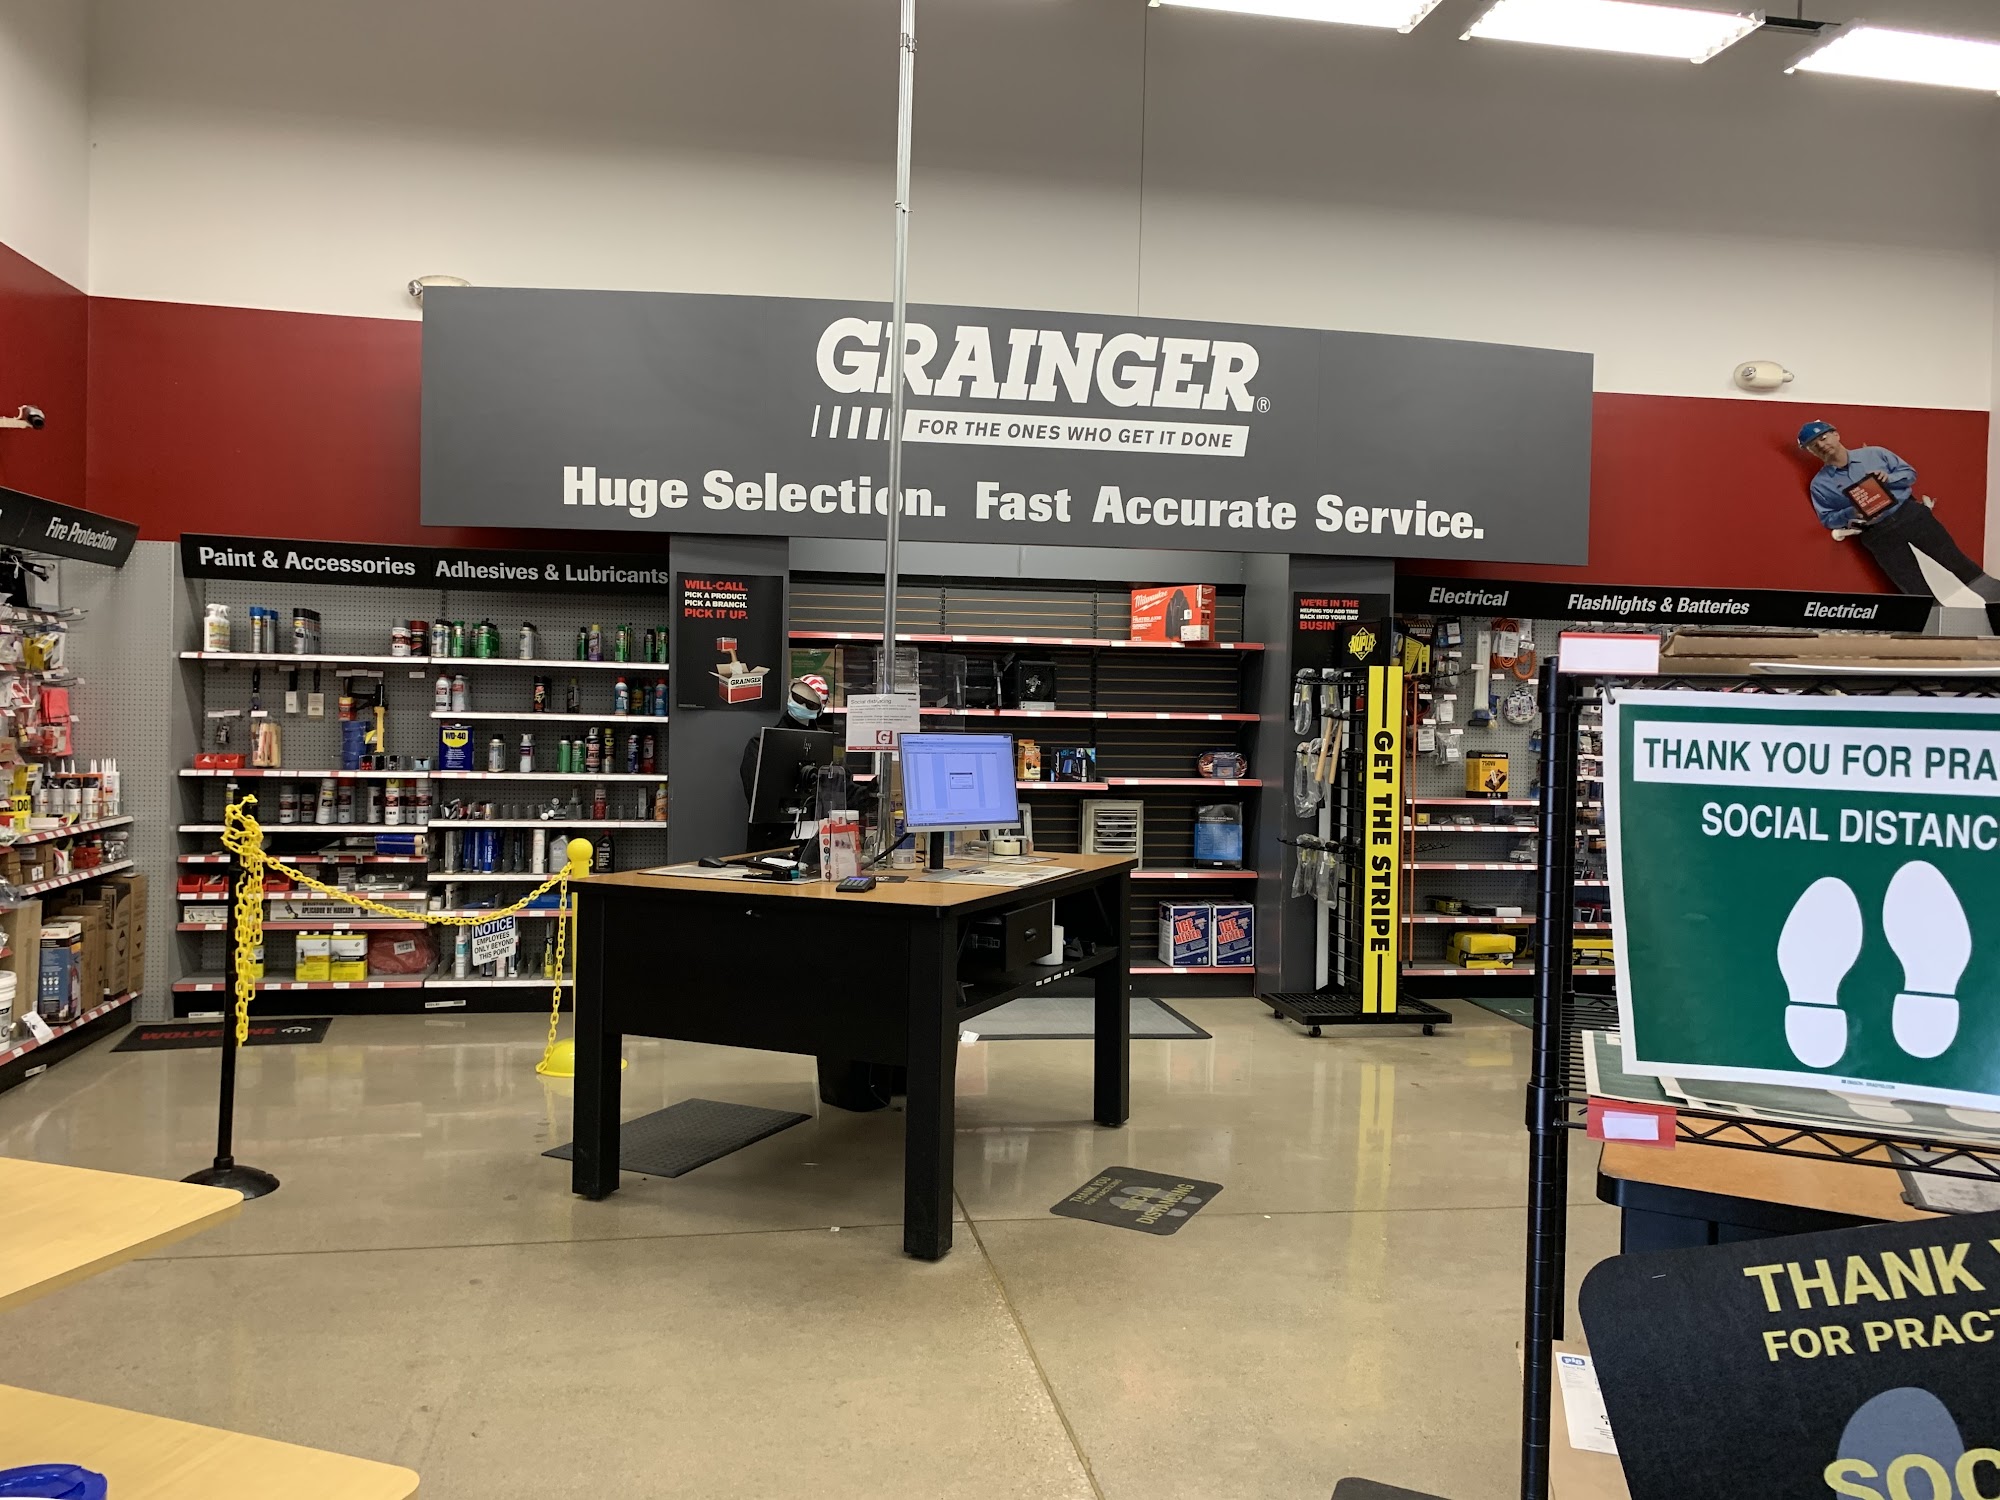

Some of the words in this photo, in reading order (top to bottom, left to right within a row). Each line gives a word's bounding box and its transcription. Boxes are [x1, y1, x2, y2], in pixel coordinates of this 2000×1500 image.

[918, 419, 958, 436] FOR
[965, 421, 1001, 437] THE
[1007, 423, 1061, 440] ONES
[1067, 426, 1112, 442] WHO
[1118, 428, 1155, 444] GET
[1159, 430, 1176, 445] IT
[1181, 432, 1233, 448] DONE
[563, 465, 688, 519] Huge
[975, 481, 1071, 523] Fast
[1092, 485, 1297, 531] Accurate
[1315, 493, 1485, 540] Service.
[45, 516, 67, 540] Fire
[67, 522, 117, 551] Protection
[199, 546, 256, 568] Paint
[262, 550, 279, 569] &
[284, 551, 416, 576] Accessories
[435, 560, 539, 580] Adhesives
[544, 564, 560, 581] &
[565, 564, 669, 585] Lubricants
[684, 579, 748, 591] WILL-CALL.
[684, 599, 703, 607] PICK
[712, 600, 747, 608] BRANCH.
[711, 592, 747, 600] PRODUCT.
[1300, 598, 1328, 607] WE'RE
[1330, 599, 1340, 607] IN
[1341, 600, 1359, 608] THE
[1429, 587, 1509, 607] Electrical
[684, 608, 714, 619] PICK
[716, 609, 726, 619] IT
[729, 609, 748, 620] UP.
[1567, 594, 1656, 617] Flashlights
[1660, 597, 1673, 613] &
[1677, 598, 1750, 616] Batteries
[1804, 601, 1878, 620] Electrical
[1300, 621, 1335, 631] BUSIN
[730, 677, 761, 686] GRAINGER
[445, 731, 466, 740] WD-40
[1374, 731, 1394, 784] GET
[1643, 738, 1752, 773] THANK
[1761, 741, 1830, 775] YOU
[1842, 743, 1911, 778] FOR
[1925, 746, 2000, 782] PRA
[1373, 794, 1393, 845] THE
[1702, 801, 1828, 842] SOCIAL
[1840, 808, 2000, 851] DISTANC
[1371, 855, 1391, 952] STRIPE
[474, 916, 513, 938] NOTICE
[1175, 918, 1195, 934] ICE
[1219, 918, 1239, 934] ICE
[476, 931, 510, 946] EMPLOYEES
[1174, 929, 1202, 945] MELTER
[1217, 929, 1245, 945] MELTER
[474, 944, 490, 955] ONLY
[491, 938, 514, 950] BEYOND
[479, 952, 492, 961] THIS
[493, 946, 510, 957] POINT
[141, 1027, 277, 1041] WOLVENE
[1068, 1187, 1100, 1203] THANK
[1135, 1183, 1195, 1225] DISTANCING
[1743, 1242, 1986, 1313] THANK
[1762, 1325, 1856, 1362] FOR
